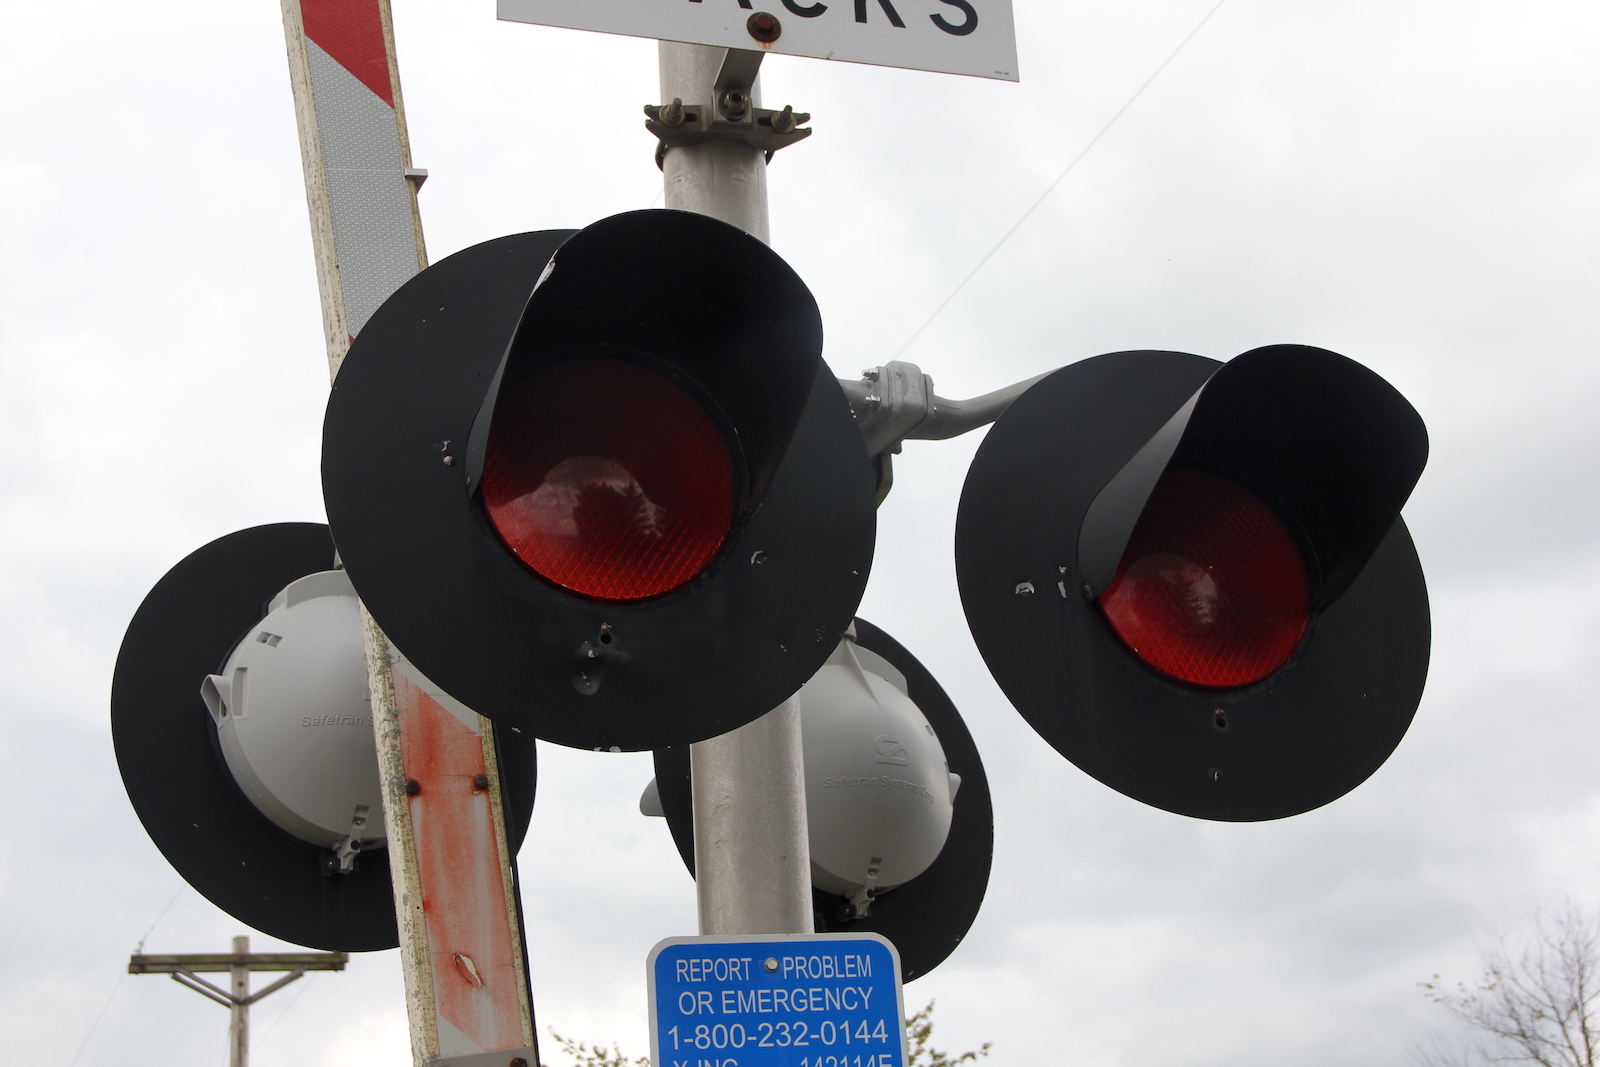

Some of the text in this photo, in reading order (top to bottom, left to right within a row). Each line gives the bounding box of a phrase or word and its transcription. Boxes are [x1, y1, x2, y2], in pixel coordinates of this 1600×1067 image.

[300, 714, 363, 727] Safetran
[822, 775, 877, 788] Safetran
[880, 776, 919, 793] Systems
[676, 954, 872, 982] REPORT PROBLEM
[678, 986, 873, 1016] OR EMERGENCY
[668, 1019, 888, 1050] 1-800-232-0144
